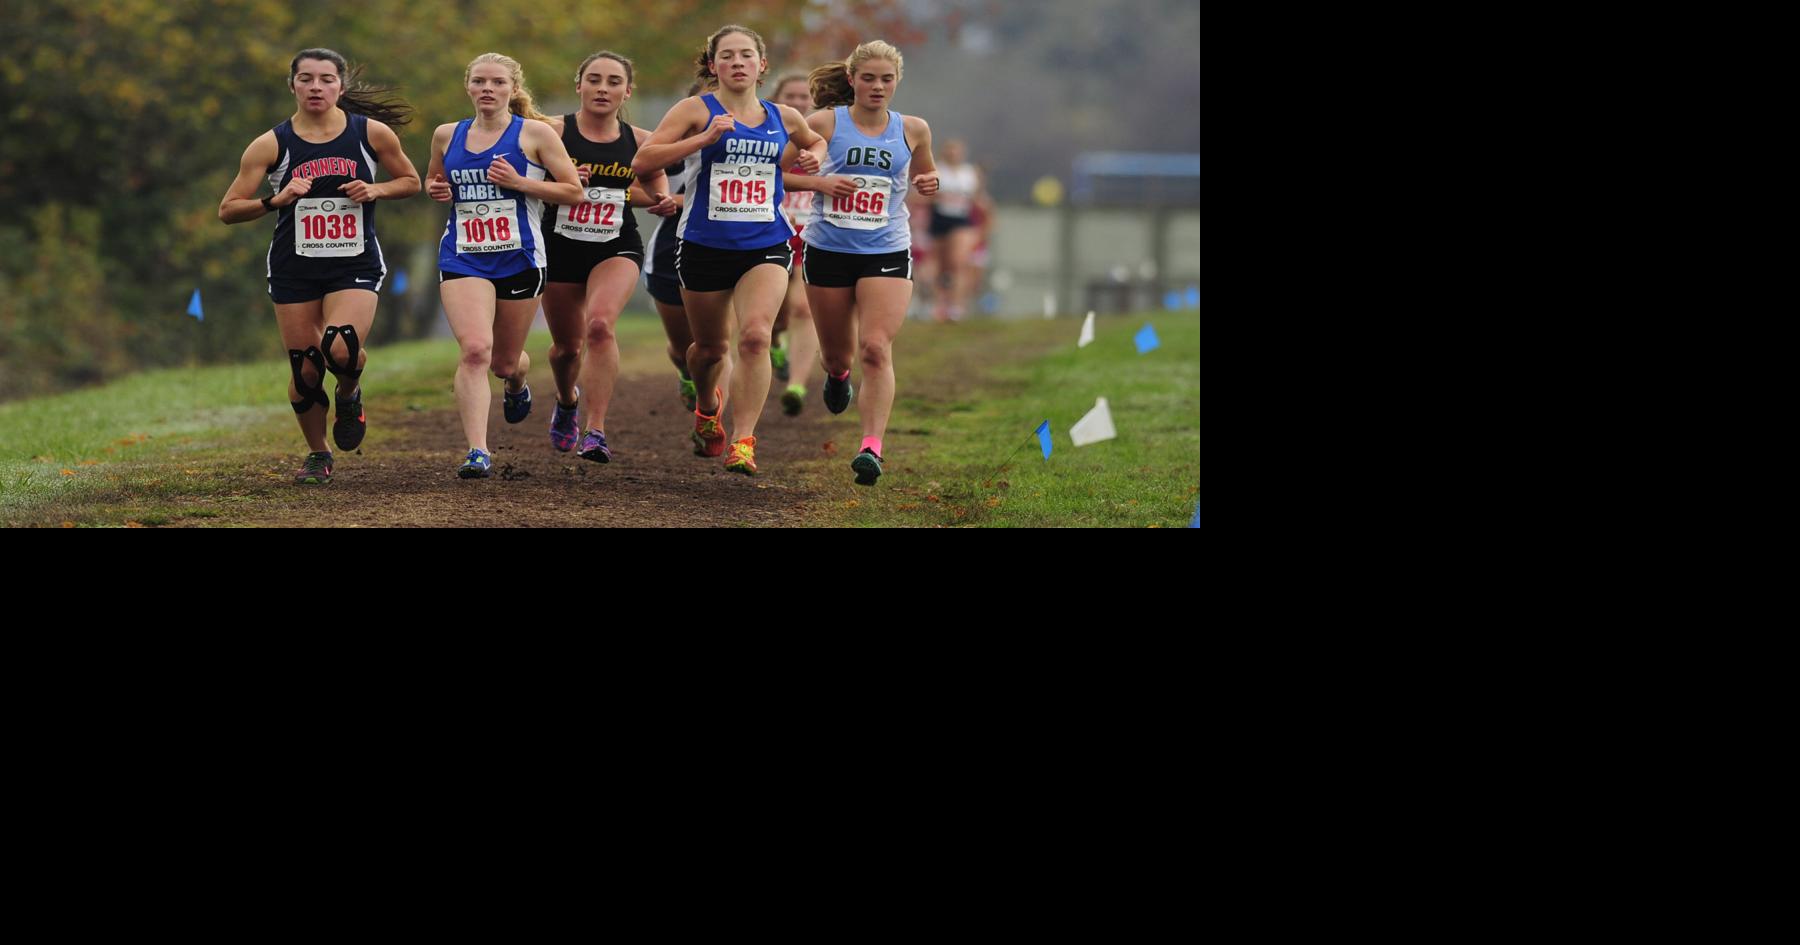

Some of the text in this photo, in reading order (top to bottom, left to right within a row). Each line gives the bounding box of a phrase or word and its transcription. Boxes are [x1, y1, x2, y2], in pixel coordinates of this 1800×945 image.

[725, 138, 779, 157] CATLIN
[845, 147, 893, 171] OES
[292, 157, 357, 178] KENNEDY
[459, 185, 504, 200] GABEL
[717, 180, 767, 205] 1015
[831, 191, 885, 215] 1066
[568, 201, 616, 226] 1012
[300, 214, 357, 240] 1038
[462, 216, 511, 243] 1018
[561, 223, 615, 235] CROSS COUNTRY
[483, 243, 515, 251] COUNTRY
